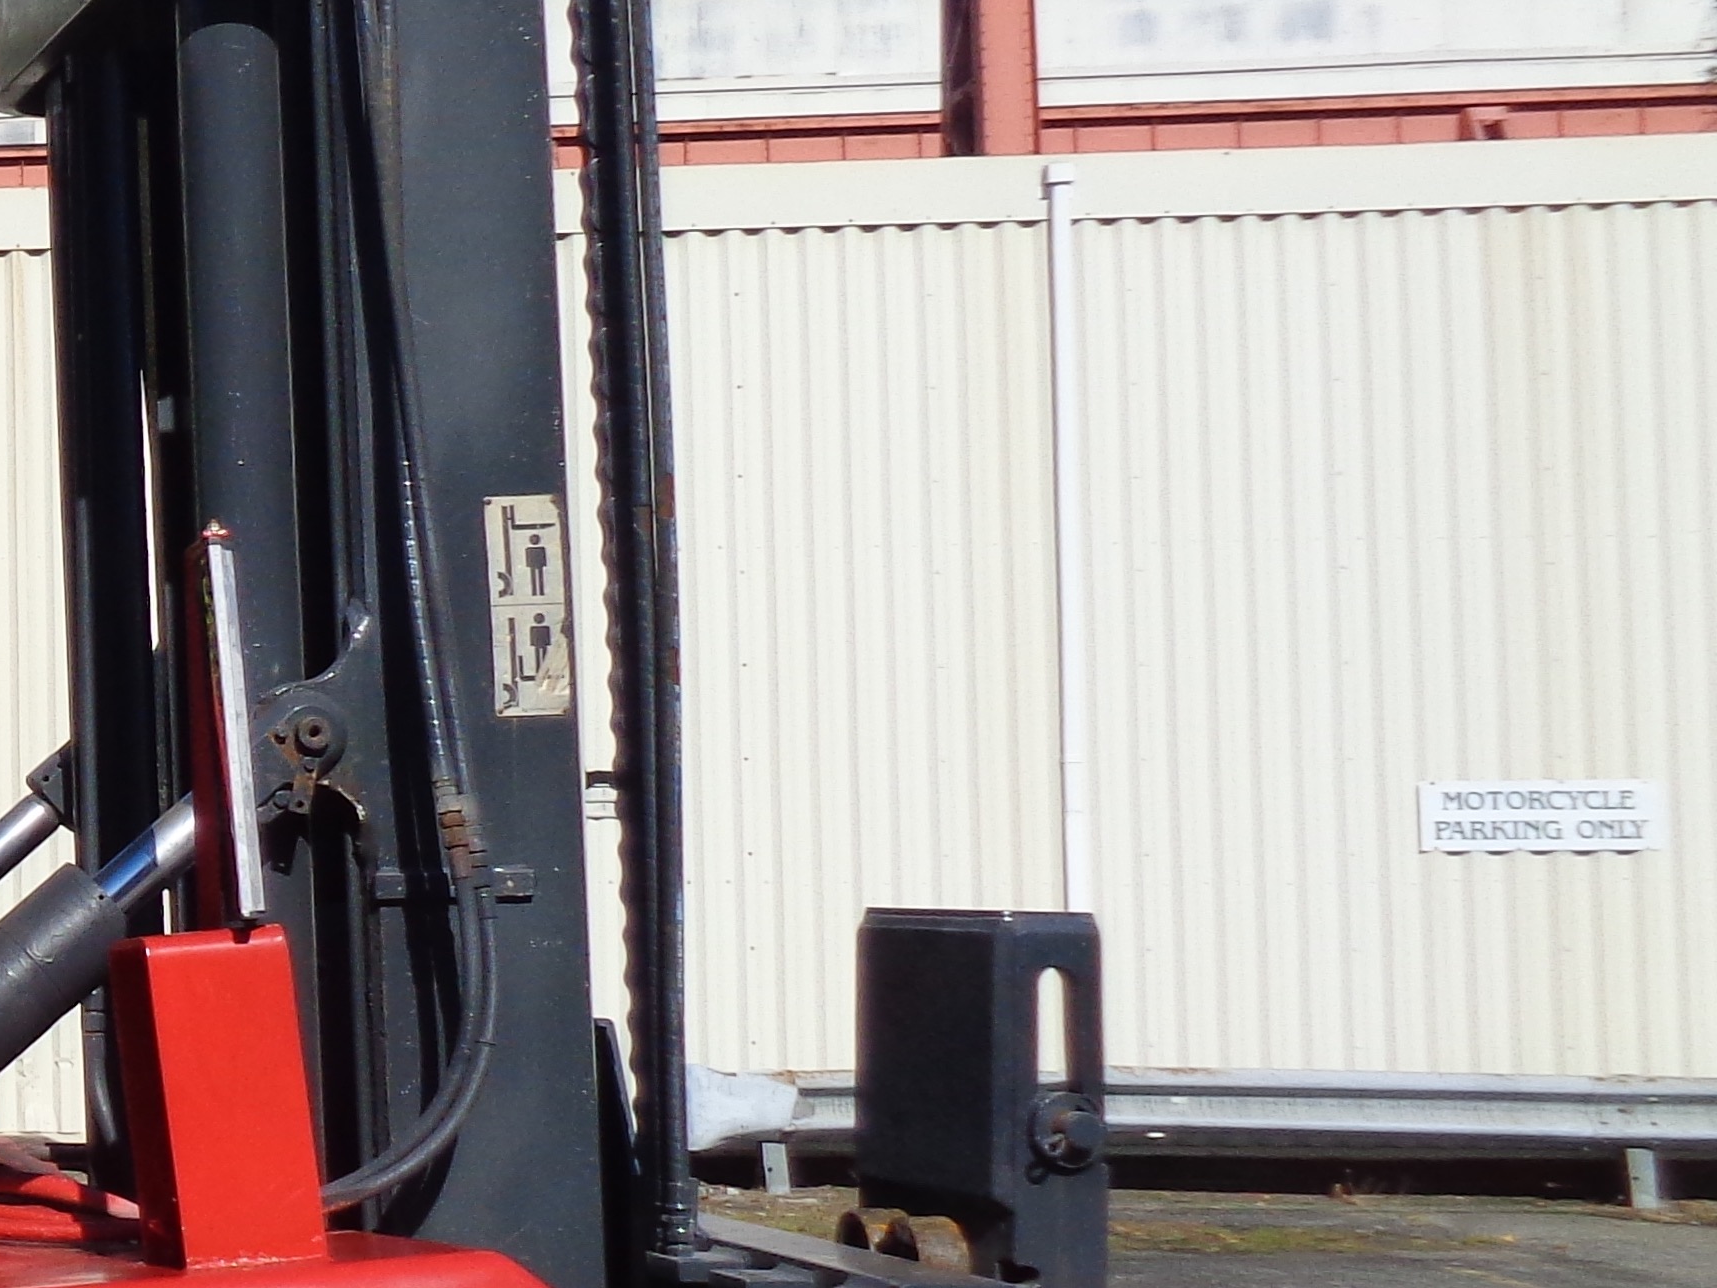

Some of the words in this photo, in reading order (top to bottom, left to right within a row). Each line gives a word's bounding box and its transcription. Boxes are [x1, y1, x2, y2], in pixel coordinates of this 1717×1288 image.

[1441, 790, 1637, 810] MOTORCYCLE
[1434, 820, 1564, 840] PARKING
[1576, 819, 1650, 839] ONLY
